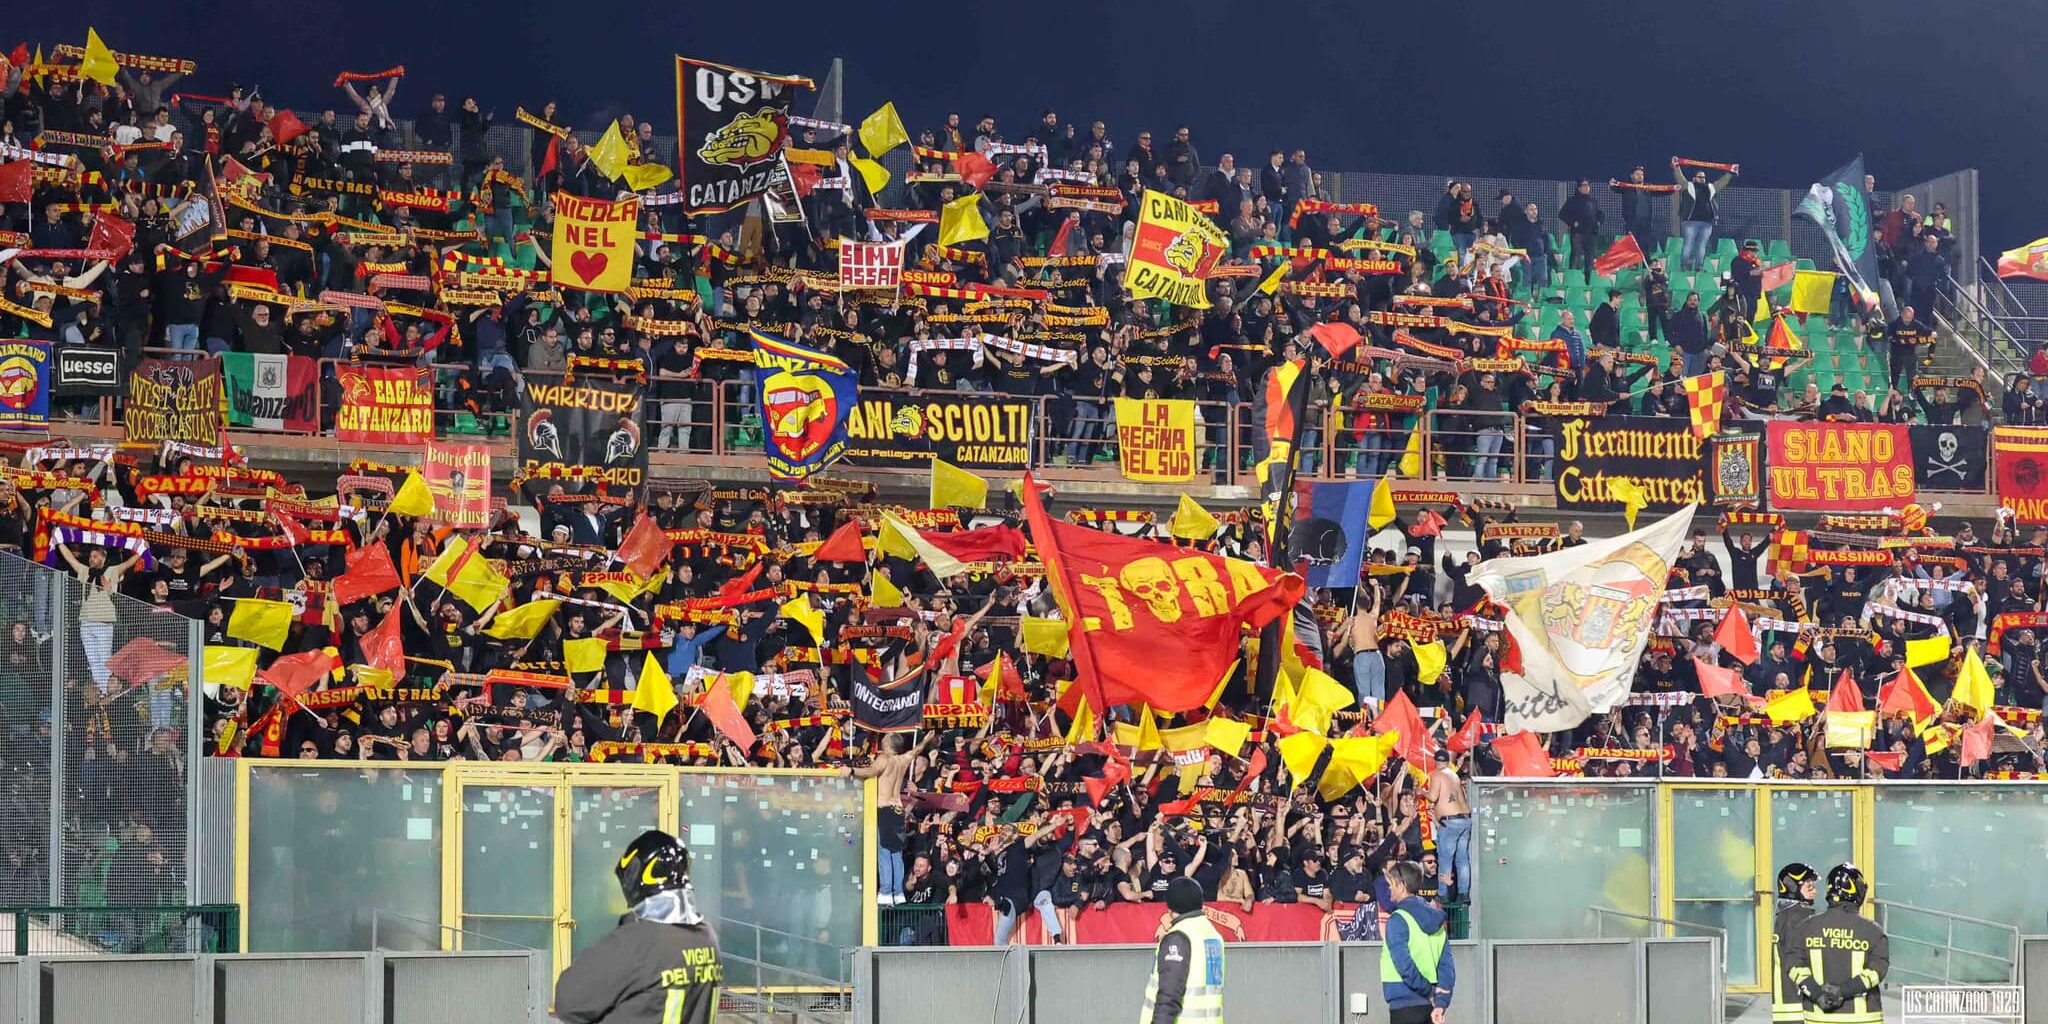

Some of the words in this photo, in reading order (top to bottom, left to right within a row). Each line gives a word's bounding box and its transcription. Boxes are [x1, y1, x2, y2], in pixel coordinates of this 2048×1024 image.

[690, 169, 774, 207] CATANZA
[556, 197, 638, 222] NICOLA
[1152, 199, 1188, 222] CANI
[566, 224, 616, 248] NEL
[365, 262, 406, 273] MASSIM
[1333, 257, 1396, 271] MASSIMO
[842, 265, 899, 286] ASSAI
[0, 344, 46, 363] TANZARO
[64, 359, 113, 374] uesse
[130, 372, 169, 410] WEST
[176, 373, 214, 410] GATE
[374, 381, 433, 405] EAGLES
[338, 404, 432, 432] CATANZARO
[848, 402, 894, 440] ANI
[928, 404, 1028, 443] SCIOLTI
[1142, 403, 1169, 427] LA
[126, 409, 167, 442] SOCCER
[169, 411, 216, 446] CASUALS
[1560, 418, 1704, 462] Fieramente
[1783, 429, 1895, 465] SIANO
[872, 449, 938, 460] Pellegrino
[957, 445, 1028, 464] CATANZARO
[1159, 451, 1191, 477] SUD
[1771, 464, 1915, 500] ULTRAS
[1410, 493, 1455, 502] CATANZARO
[1500, 527, 1550, 536] ULTRAS
[1815, 551, 1886, 563] MASSIMO
[297, 689, 360, 706] MASSIM
[1822, 927, 1854, 939] VIGILI
[1805, 937, 1826, 948] DEL
[1830, 938, 1869, 951] FUOCO
[682, 947, 716, 966] VIGILI
[661, 969, 690, 987] DEL
